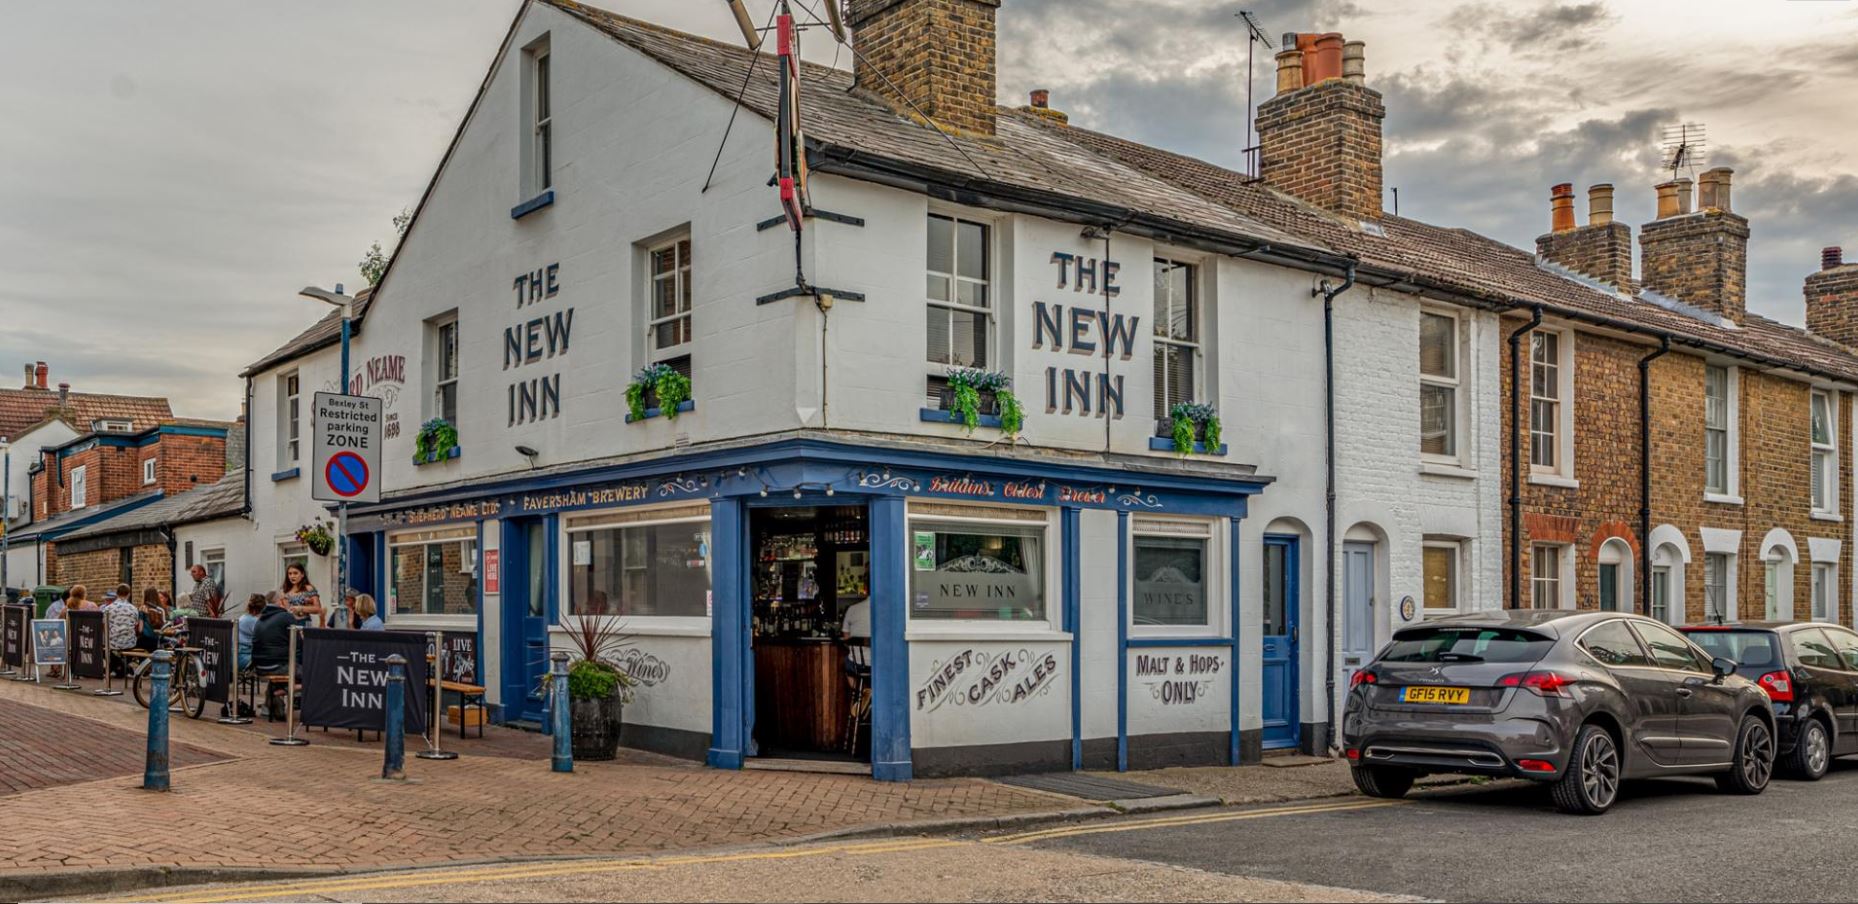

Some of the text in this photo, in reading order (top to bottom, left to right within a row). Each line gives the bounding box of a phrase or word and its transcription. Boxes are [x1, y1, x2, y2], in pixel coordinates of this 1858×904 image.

[1050, 252, 1120, 297] THE
[513, 262, 560, 310] THE
[503, 307, 574, 371] NEW
[1032, 301, 1140, 361] NEW
[366, 354, 406, 392] NEAME
[328, 398, 369, 409] Bexley St
[508, 373, 560, 428] INN
[1045, 366, 1124, 420] INN
[320, 407, 377, 422] Restricted
[327, 423, 369, 435] parking
[384, 421, 400, 440] 1698
[327, 434, 369, 448] ZONE
[523, 485, 648, 511] FAVERSHAM BREWERY
[408, 508, 446, 524] SHEPHERD
[450, 503, 478, 519] NEAME
[940, 584, 1016, 598] NEW INN
[1144, 593, 1193, 605] WINES
[80, 635, 93, 649] NEW
[204, 636, 214, 646] THE
[453, 639, 472, 651] LIVE
[81, 650, 92, 664] INN
[350, 651, 376, 663] THE
[1136, 655, 1169, 676] MALT
[1174, 656, 1185, 675] &
[336, 665, 389, 686] NEW
[917, 649, 973, 710] FINEST
[967, 651, 1016, 704] CASK
[1011, 654, 1057, 703] ALES
[342, 688, 383, 709] INN
[1161, 680, 1198, 705] ONLY
[1410, 688, 1463, 701] GF15 RVY
